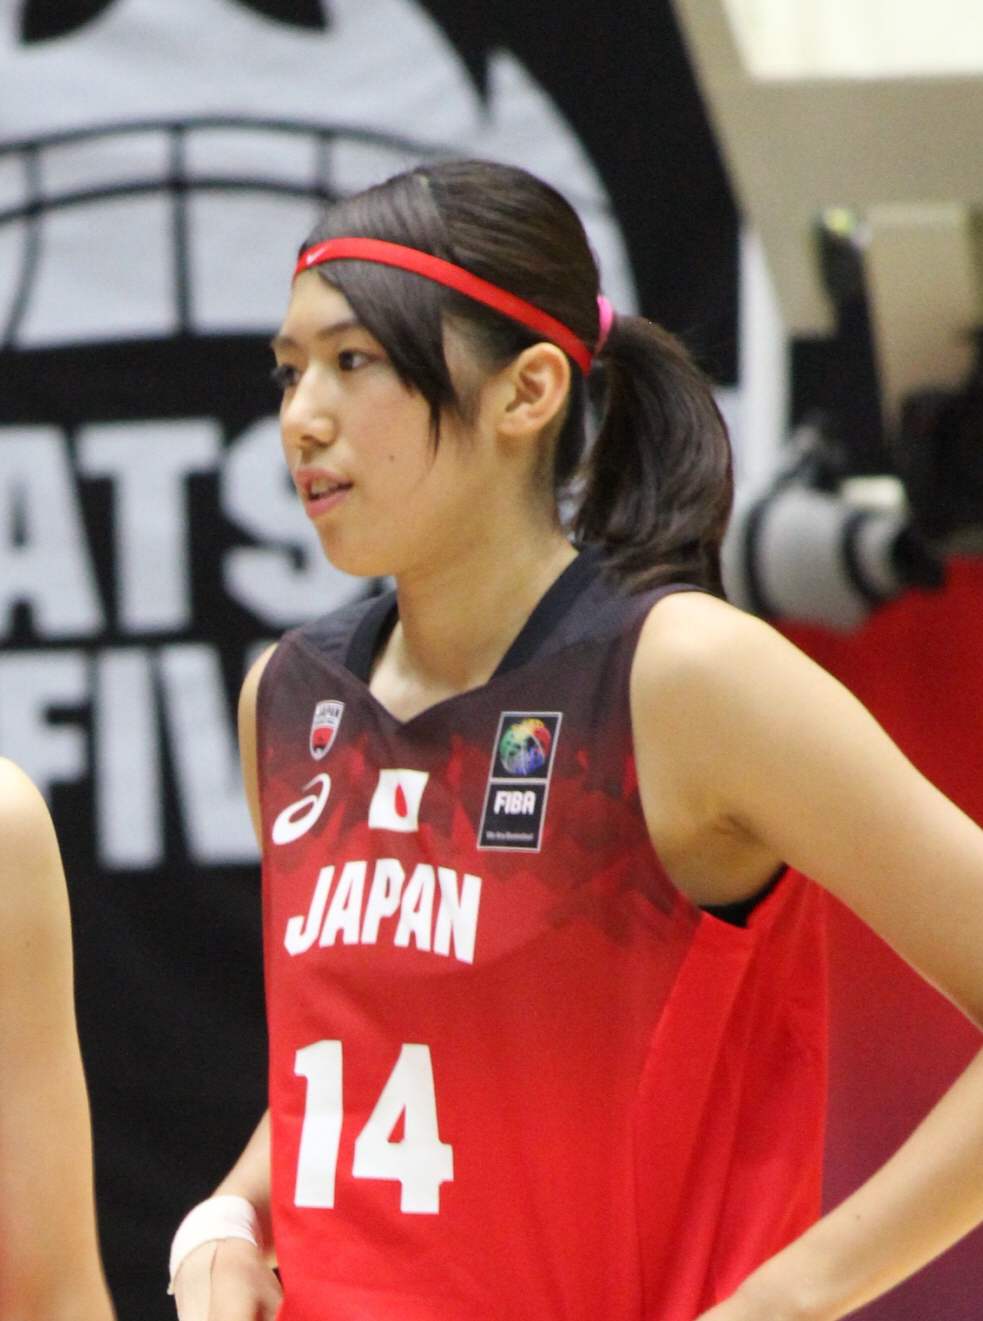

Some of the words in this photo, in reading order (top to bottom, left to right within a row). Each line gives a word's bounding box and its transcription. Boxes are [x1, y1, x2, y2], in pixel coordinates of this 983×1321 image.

[493, 790, 536, 815] FIBA
[283, 857, 483, 965] JAPAN
[293, 1039, 454, 1215] 14
